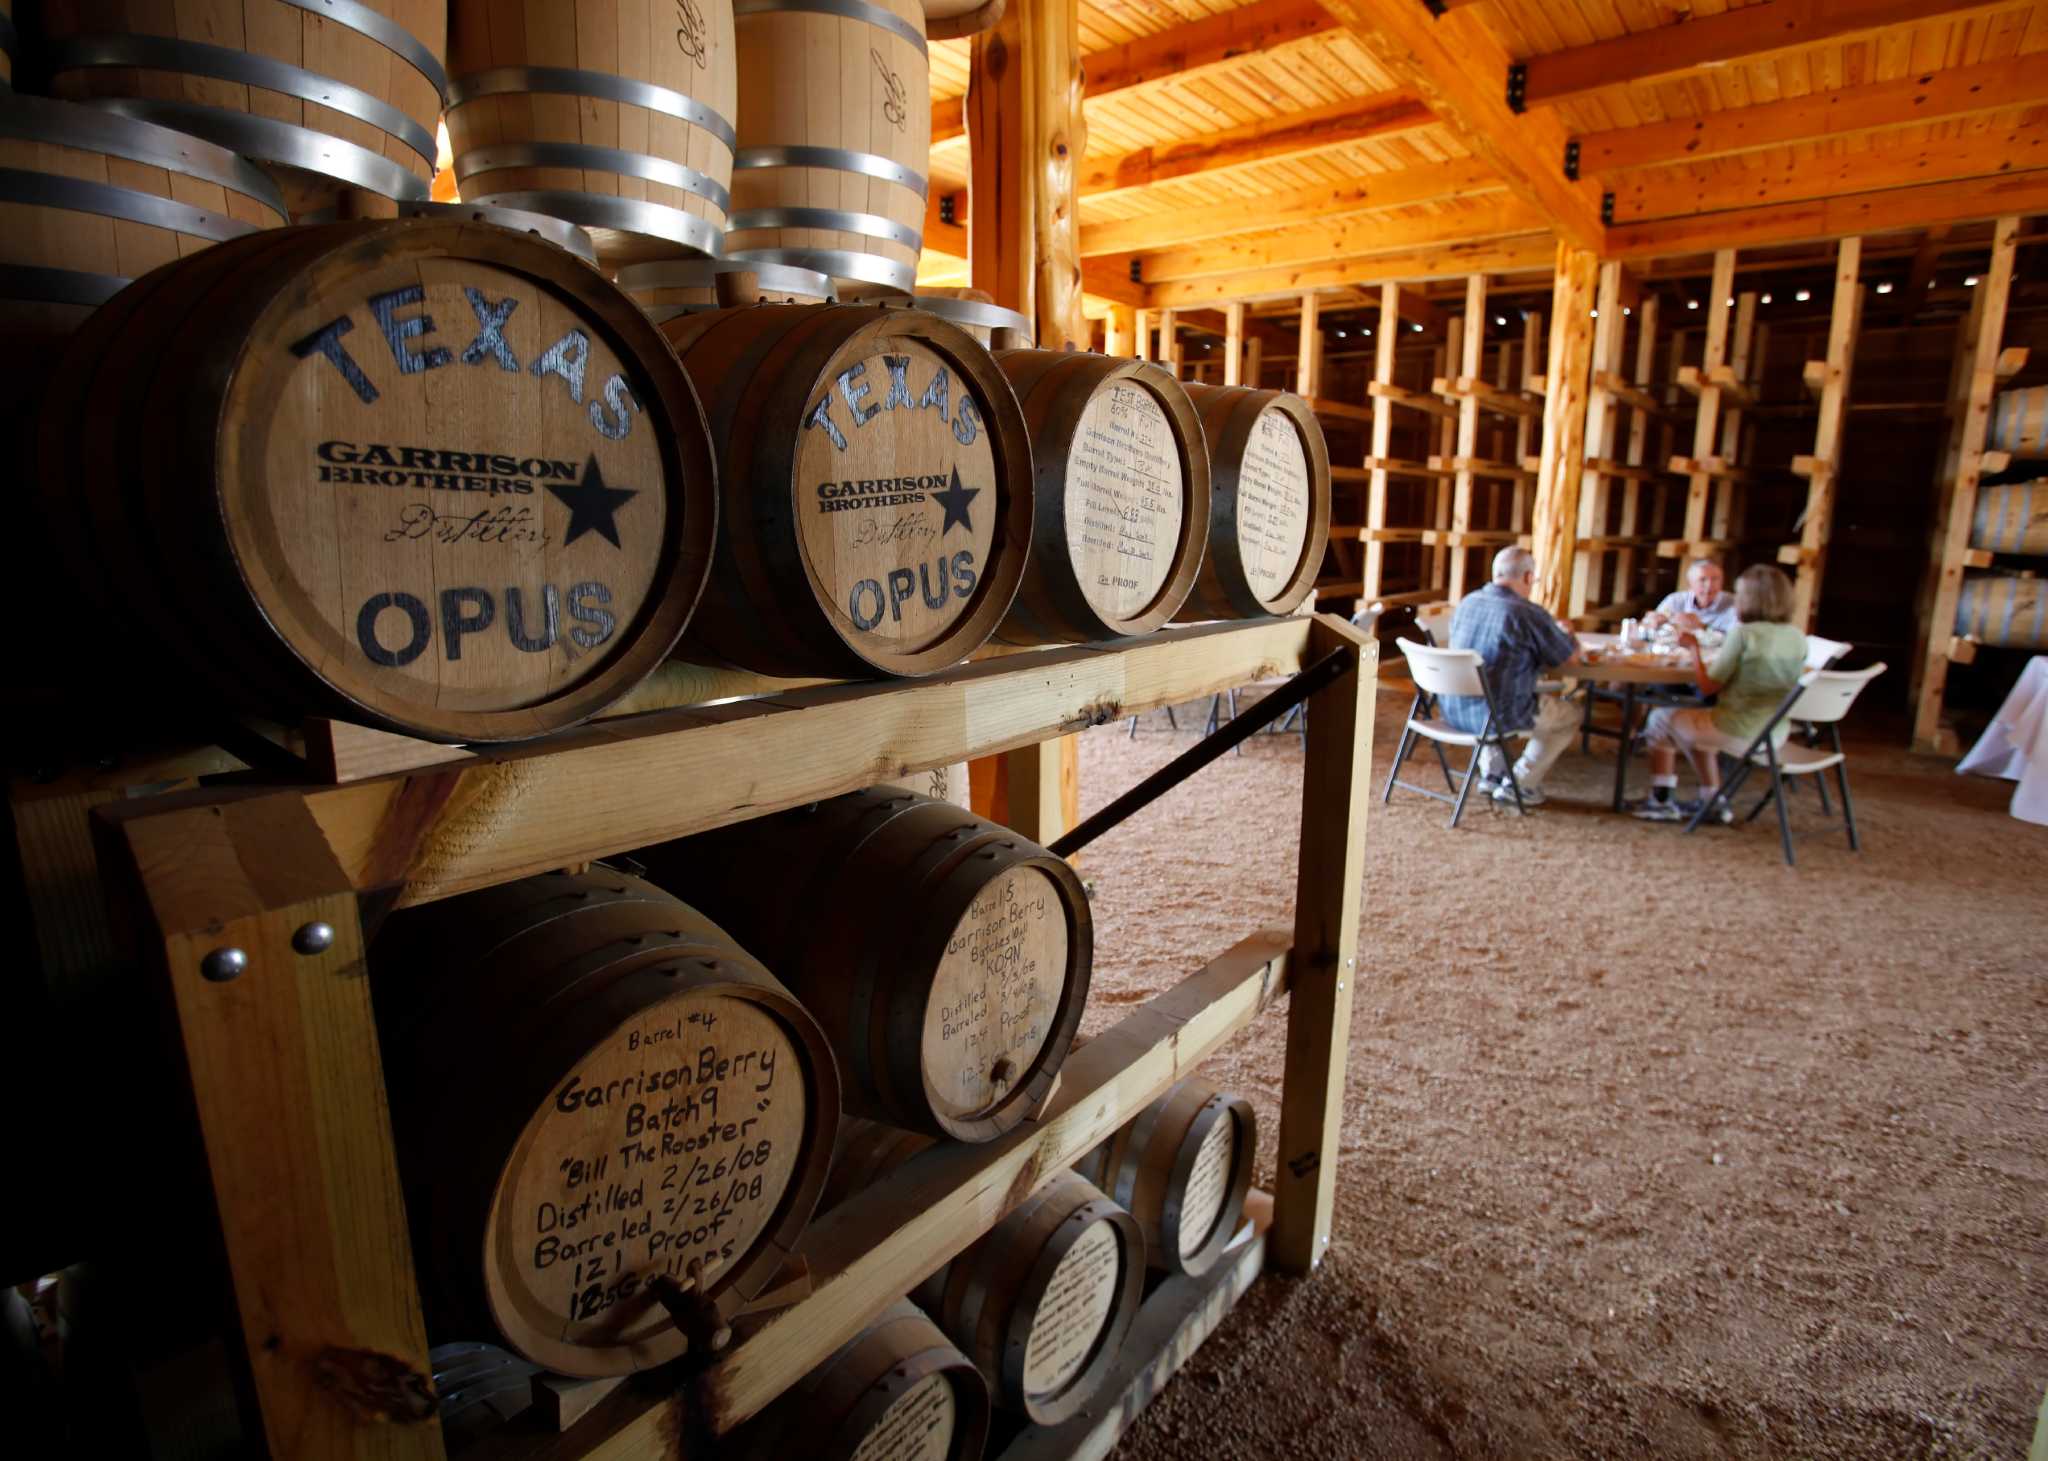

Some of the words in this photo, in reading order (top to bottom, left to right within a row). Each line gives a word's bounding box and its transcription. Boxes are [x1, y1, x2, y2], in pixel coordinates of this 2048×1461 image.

[290, 284, 643, 440] TEXAS
[804, 354, 982, 452] TEXAS
[316, 440, 580, 481] GARRISON
[316, 465, 534, 496] BROTHERS
[816, 474, 950, 500] GARRISON
[818, 492, 926, 514] BROTHERS
[384, 502, 553, 549] Distillery
[851, 512, 936, 549] Distillery
[849, 550, 977, 631] OPUS
[1111, 575, 1140, 590] PROOF
[356, 582, 615, 668] OPUS
[971, 886, 1003, 921] Barrel
[948, 916, 1007, 955] Garrison
[1009, 897, 1046, 923] Berry
[941, 982, 987, 1022] Distilled
[942, 1002, 988, 1041] Barreled
[628, 1019, 682, 1050] Barrel
[688, 1012, 717, 1033] #4
[556, 1062, 692, 1113] Garrison
[696, 1046, 776, 1093] Berry
[626, 1093, 700, 1138] Batch
[701, 1087, 719, 1113] 9
[620, 1144, 655, 1168] The
[537, 1180, 644, 1234] Distilled
[661, 1139, 772, 1196] 2/26/08
[534, 1210, 651, 1269] Barreled
[662, 1174, 764, 1226] 2/26/08
[574, 1250, 623, 1287] 121
